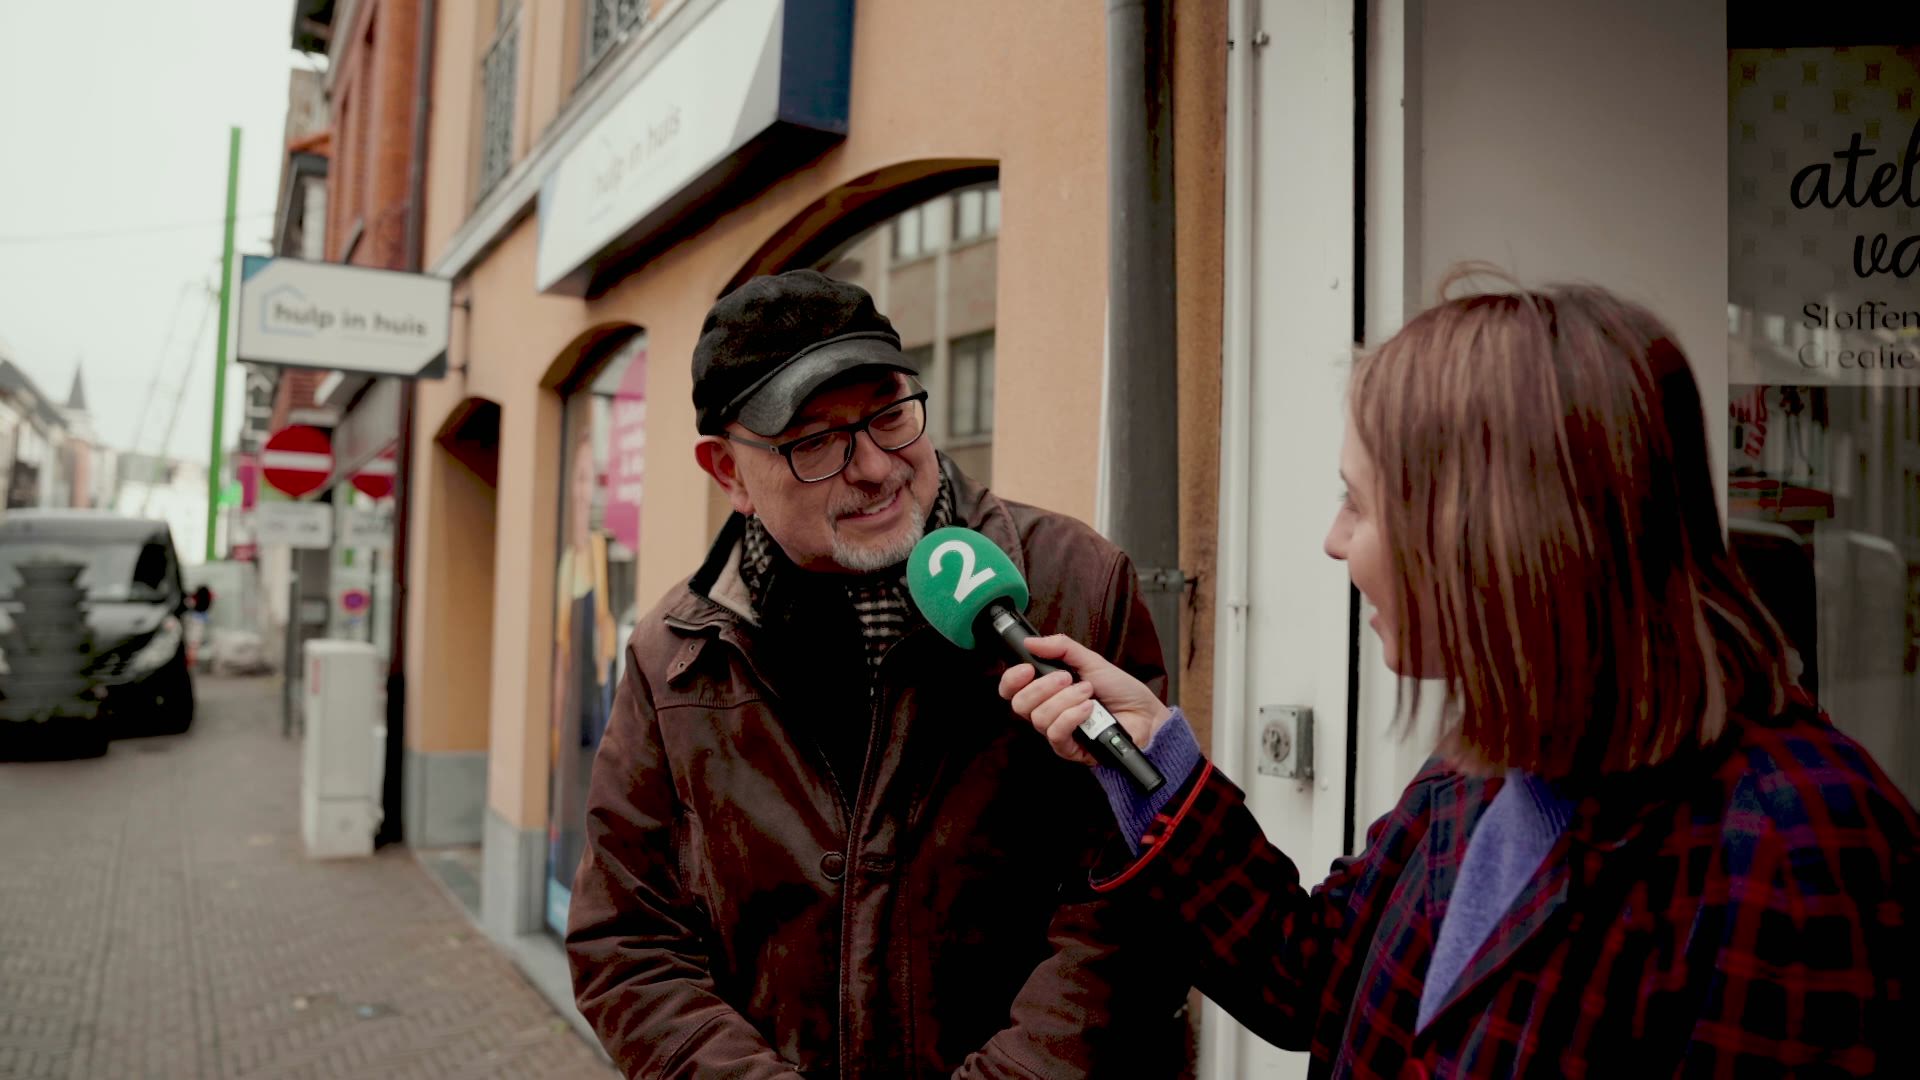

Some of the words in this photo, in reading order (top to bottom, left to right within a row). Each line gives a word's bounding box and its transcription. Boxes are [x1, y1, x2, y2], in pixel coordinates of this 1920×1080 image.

[273, 301, 335, 332] hulp
[341, 307, 367, 329] in
[373, 311, 428, 338] huis
[1802, 301, 1920, 330] Stoffen
[928, 540, 996, 603] 2
